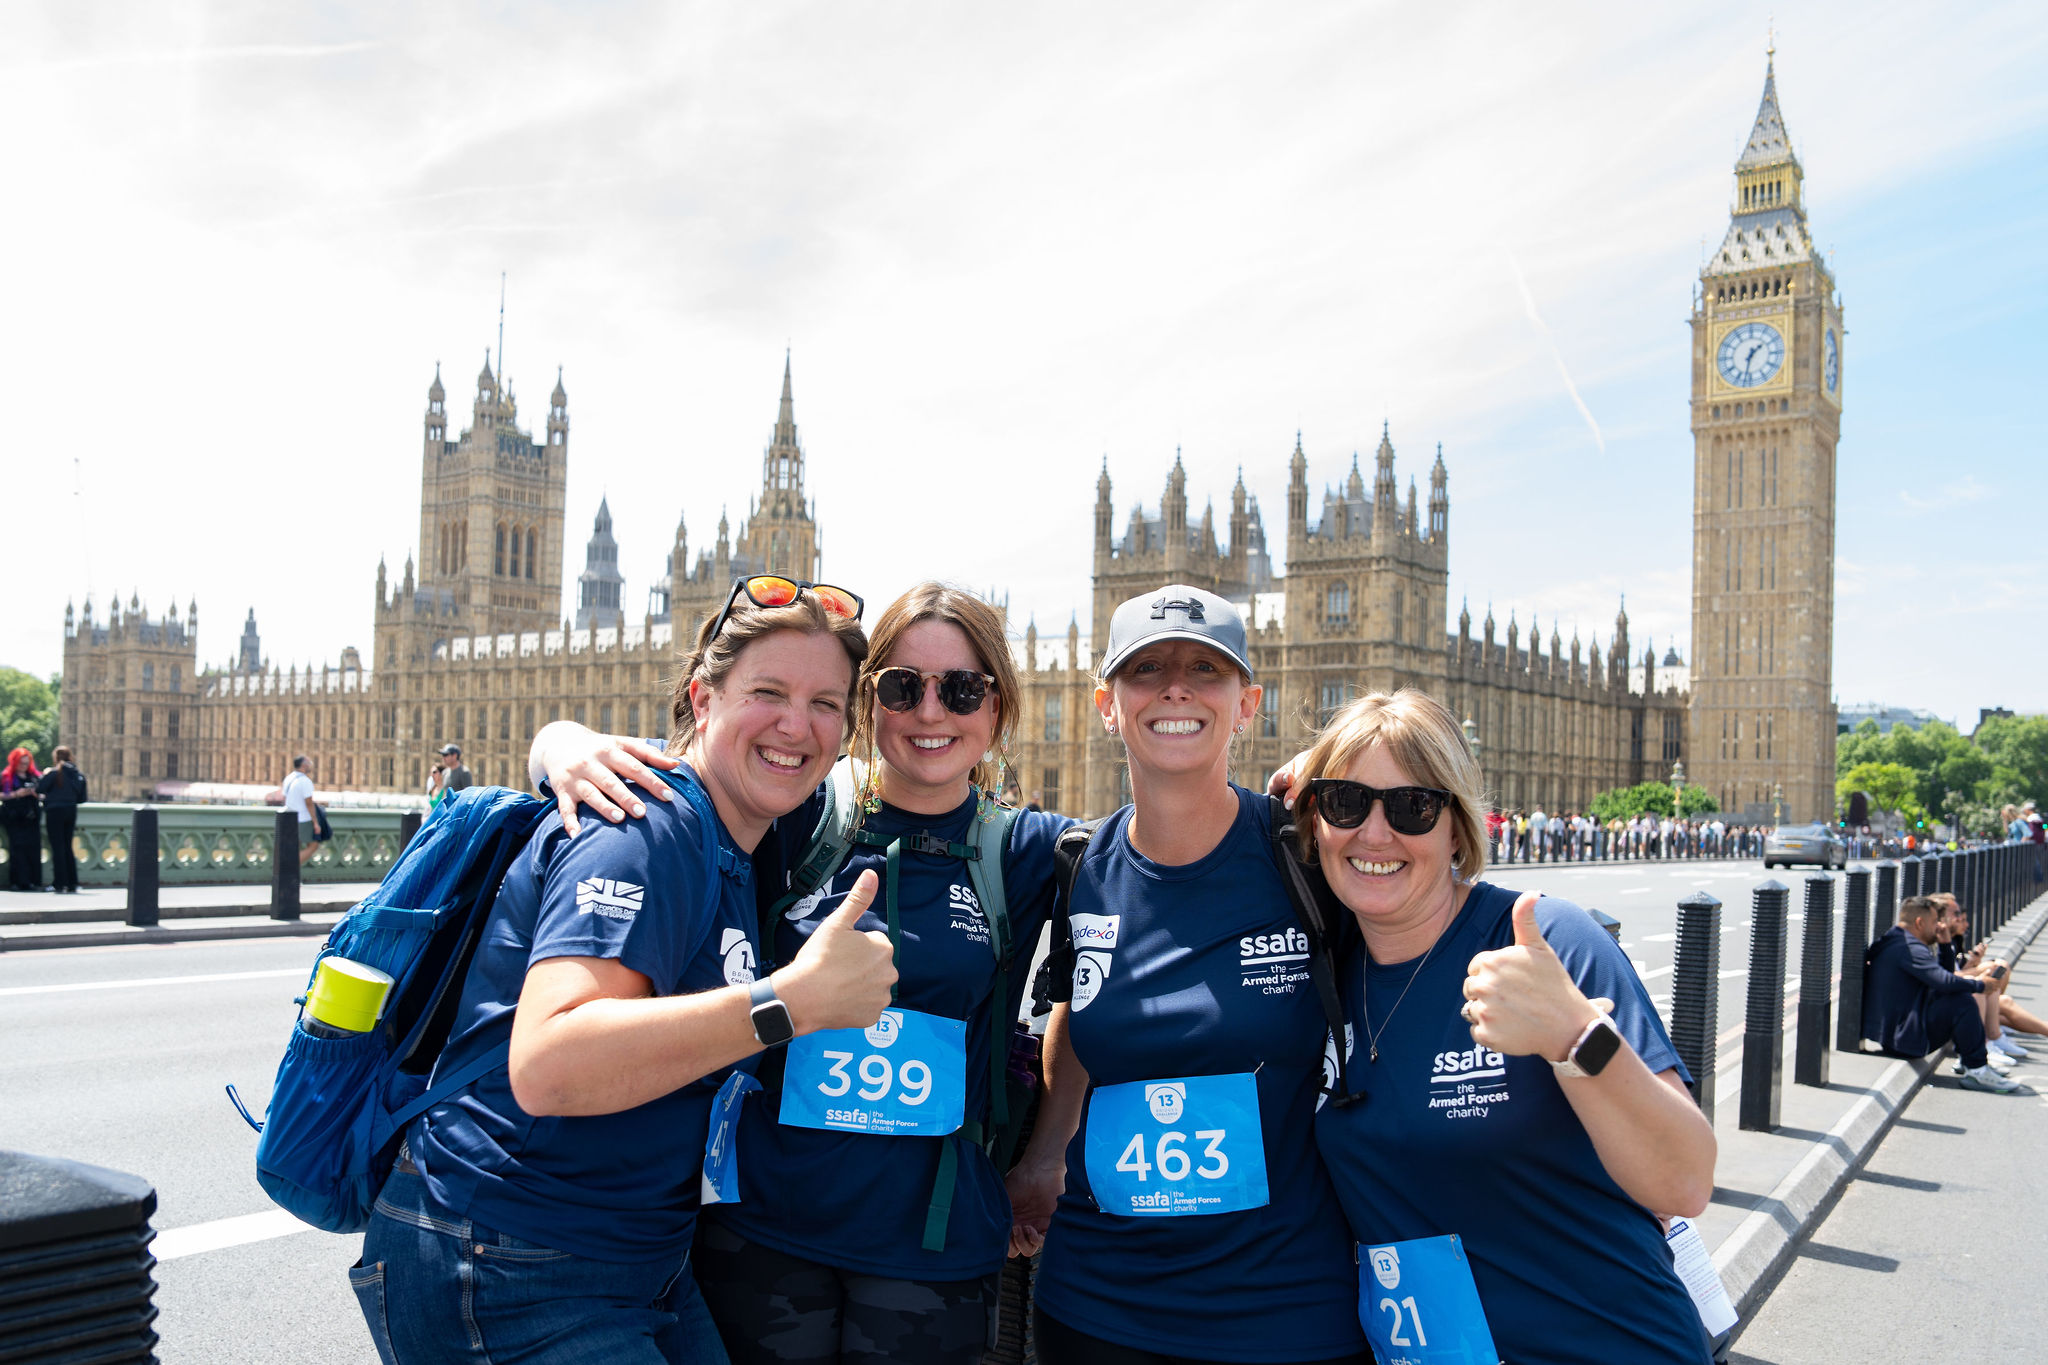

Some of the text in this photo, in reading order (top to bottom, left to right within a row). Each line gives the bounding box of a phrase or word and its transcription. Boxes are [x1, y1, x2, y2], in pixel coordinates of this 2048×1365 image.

[949, 884, 980, 910] ssa
[950, 920, 978, 933] Armed
[966, 932, 989, 945] charity
[1240, 927, 1309, 956] ssafa
[1270, 964, 1287, 974] the
[1241, 971, 1310, 987] Armed Forces
[1262, 983, 1297, 995] charity
[876, 1020, 890, 1033] 13
[1432, 1043, 1505, 1073] ssafa
[817, 1050, 932, 1106] 399
[1457, 1083, 1475, 1094] the
[1158, 1094, 1174, 1107] 13
[1428, 1091, 1510, 1108] Armed Forces
[825, 1108, 868, 1124] ssafa
[872, 1110, 884, 1118] the
[1446, 1106, 1489, 1119] charity
[870, 1124, 895, 1133] charity
[871, 1118, 919, 1127] Armed Forces
[1115, 1129, 1229, 1181] 463
[1130, 1191, 1170, 1207] ssafa
[1173, 1190, 1184, 1198] the
[1173, 1196, 1221, 1205] Armed Forces
[1173, 1204, 1198, 1213] charity
[1378, 1259, 1392, 1272] 13
[1379, 1296, 1427, 1346] 21
